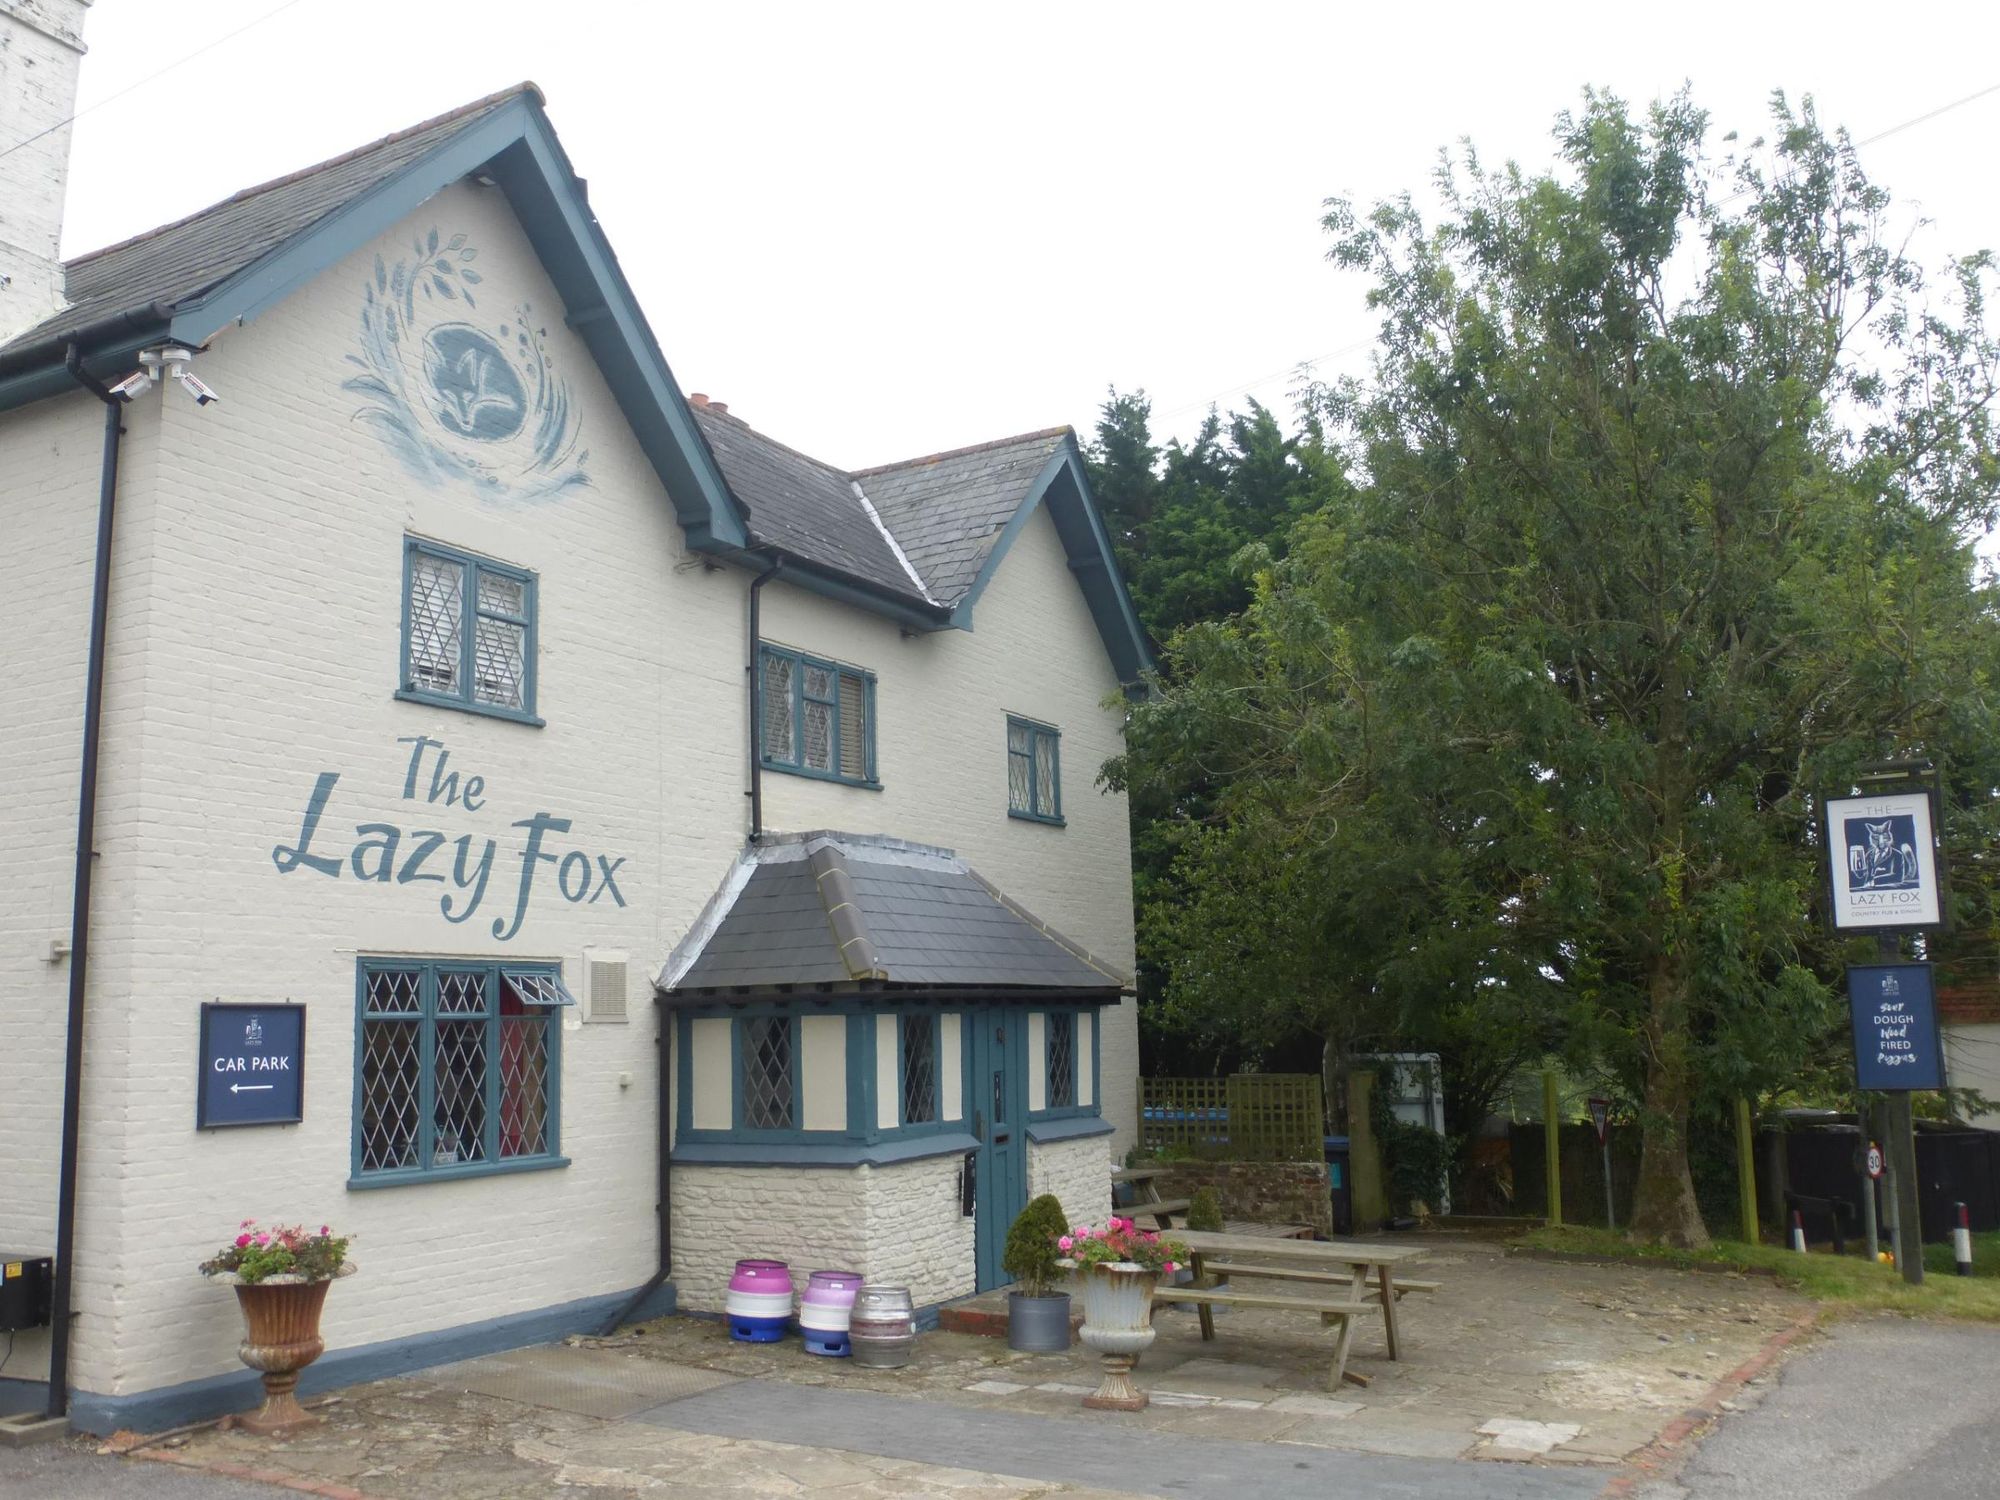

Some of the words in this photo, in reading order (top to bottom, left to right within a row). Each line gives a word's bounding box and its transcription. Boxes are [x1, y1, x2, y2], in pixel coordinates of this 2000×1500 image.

[397, 736, 486, 811] The
[1865, 805, 1892, 815] THE
[272, 772, 496, 923] Lazy
[492, 812, 628, 941] Fox
[1850, 893, 1886, 905] LAZY
[1891, 892, 1920, 903] FOX
[1873, 1015, 1914, 1024] DOUGH
[1880, 1040, 1911, 1050] FIRED
[214, 1057, 246, 1072] CAR
[252, 1056, 289, 1071] PARK
[1870, 1155, 1880, 1168] 30
